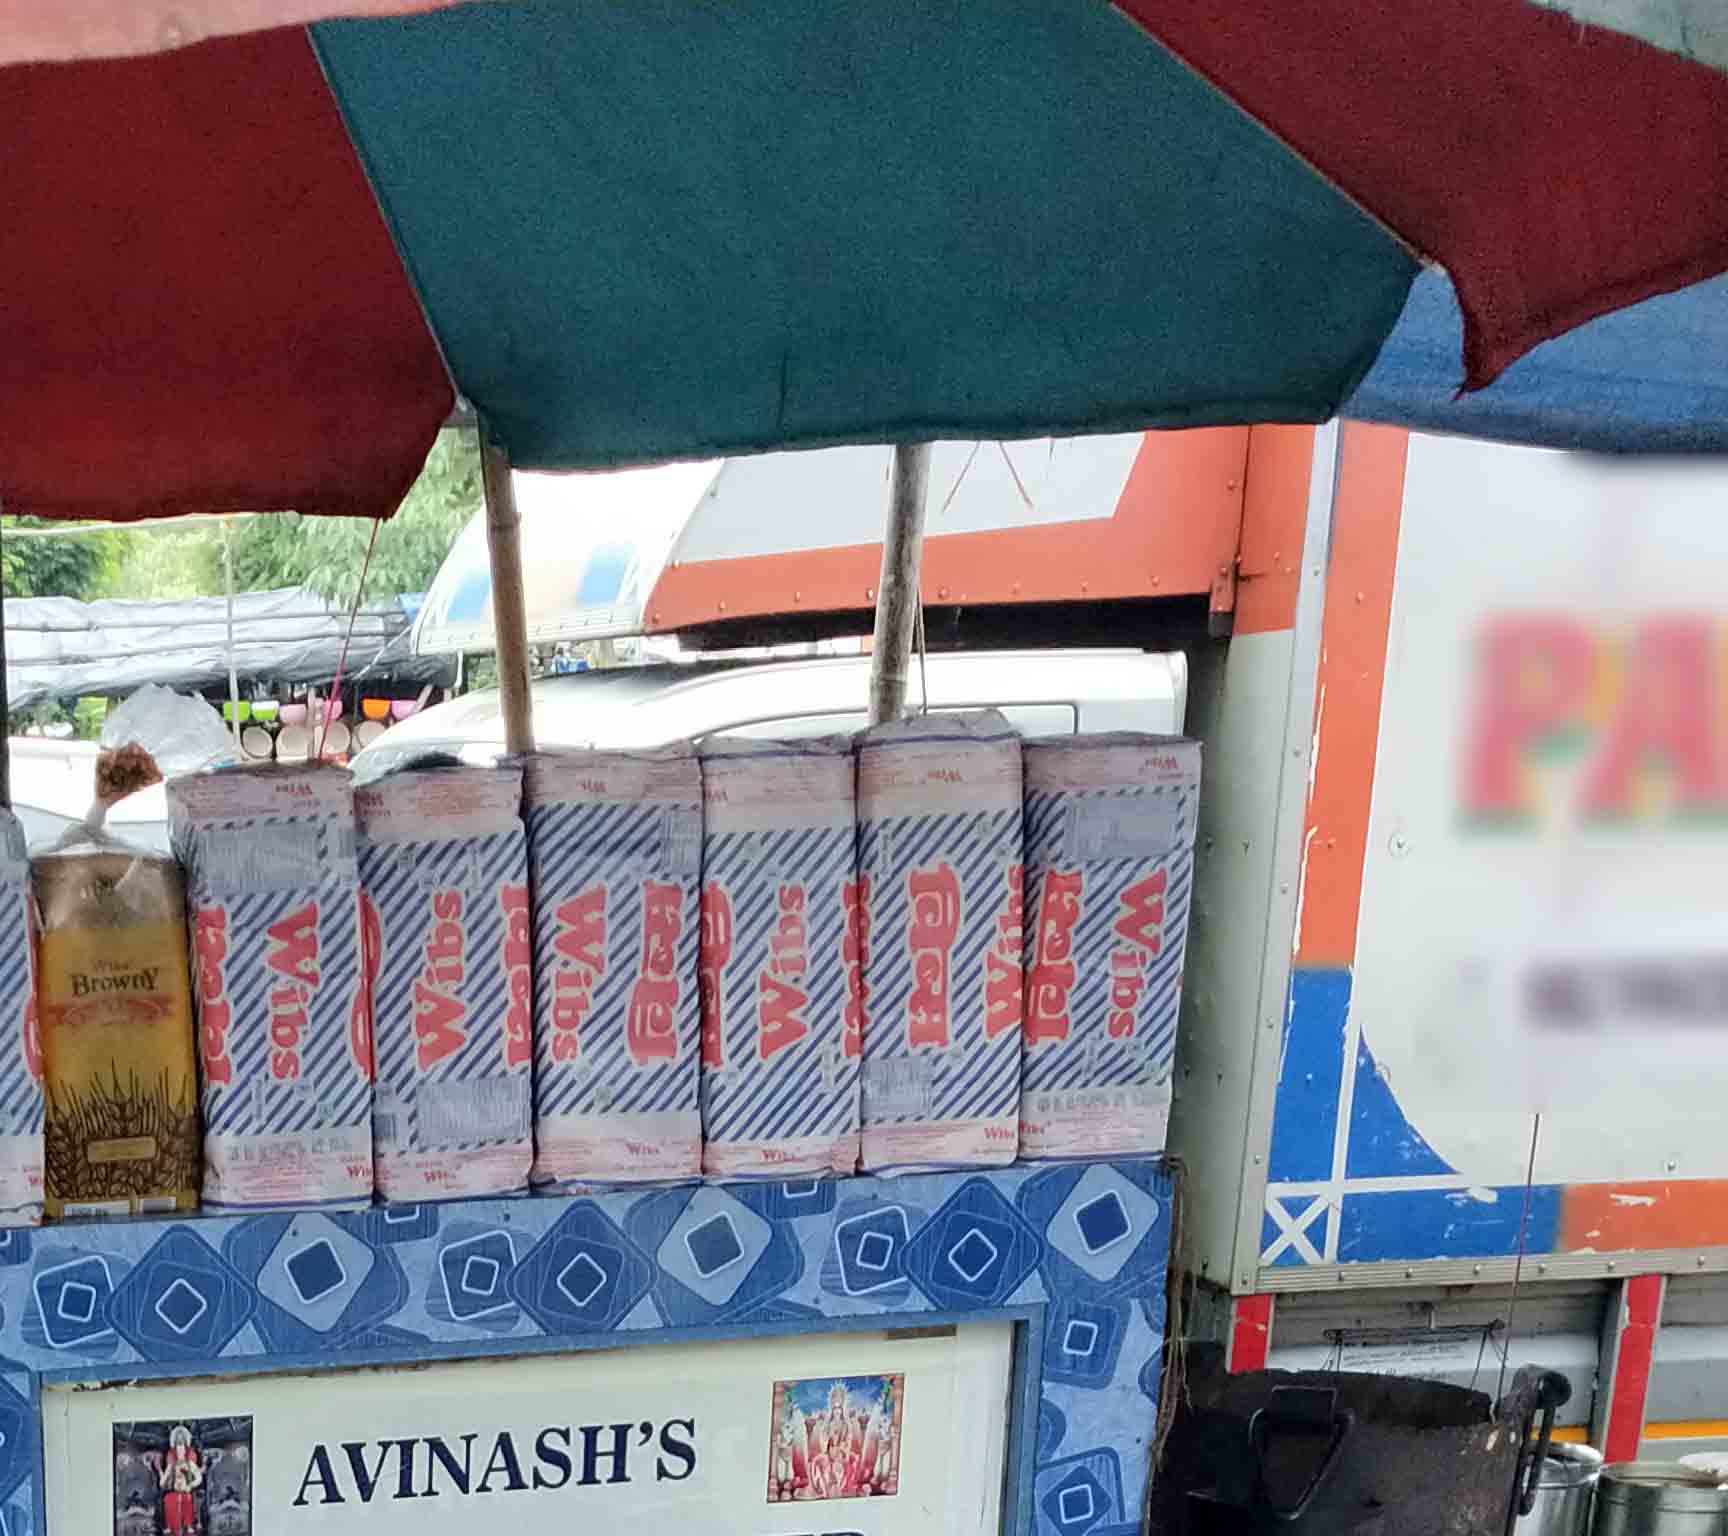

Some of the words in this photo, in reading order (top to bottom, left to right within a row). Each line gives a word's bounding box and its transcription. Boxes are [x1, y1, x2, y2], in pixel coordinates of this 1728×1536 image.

[267, 901, 320, 1080] Wibs
[414, 889, 466, 1071] Wibs
[551, 882, 606, 1063] Wibs
[759, 883, 808, 1060] Wibs
[1108, 867, 1168, 1039] Wibs
